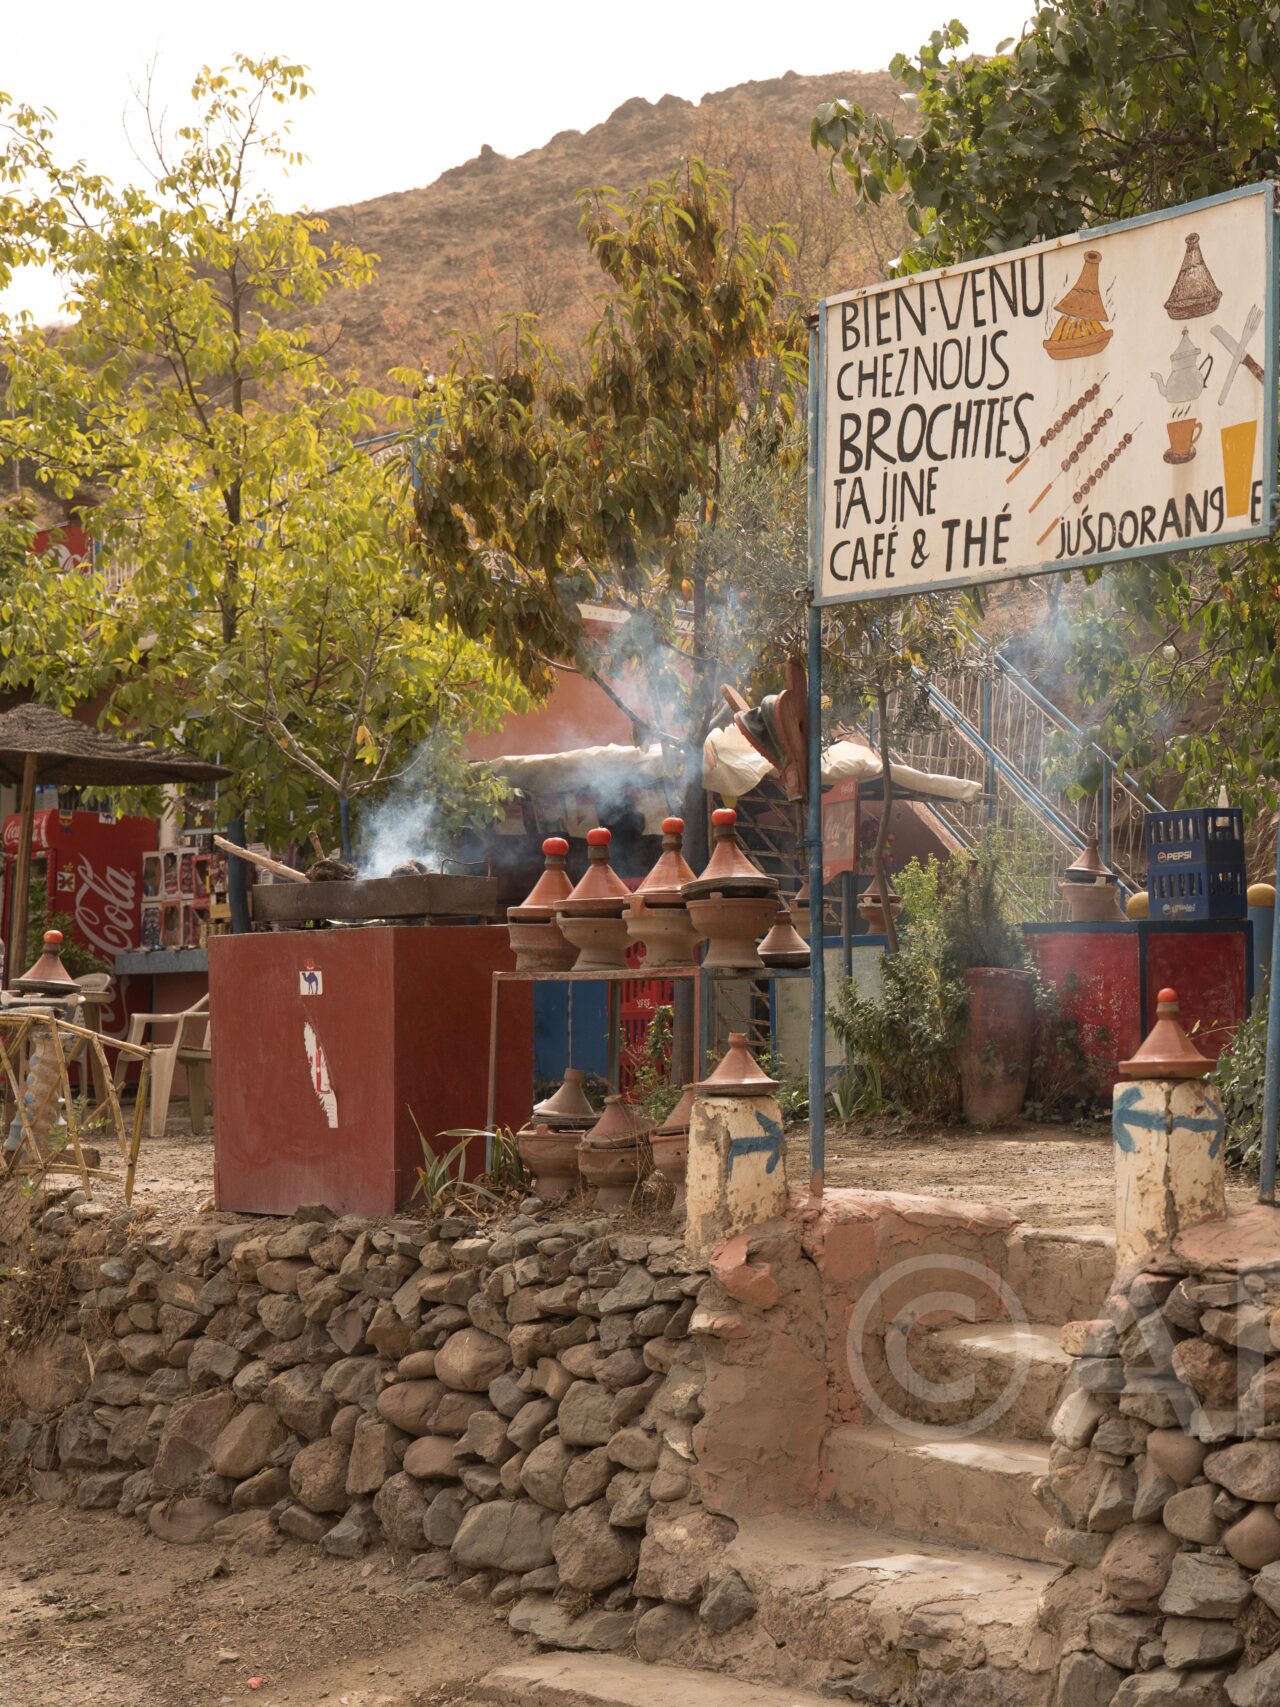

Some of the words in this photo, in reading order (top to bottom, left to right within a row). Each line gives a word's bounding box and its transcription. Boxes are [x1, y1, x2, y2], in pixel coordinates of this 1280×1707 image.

[829, 524, 898, 582] CAFÉ
[910, 528, 930, 569] &
[941, 502, 1012, 573] THÉ
[1167, 850, 1192, 861] PEPSI
